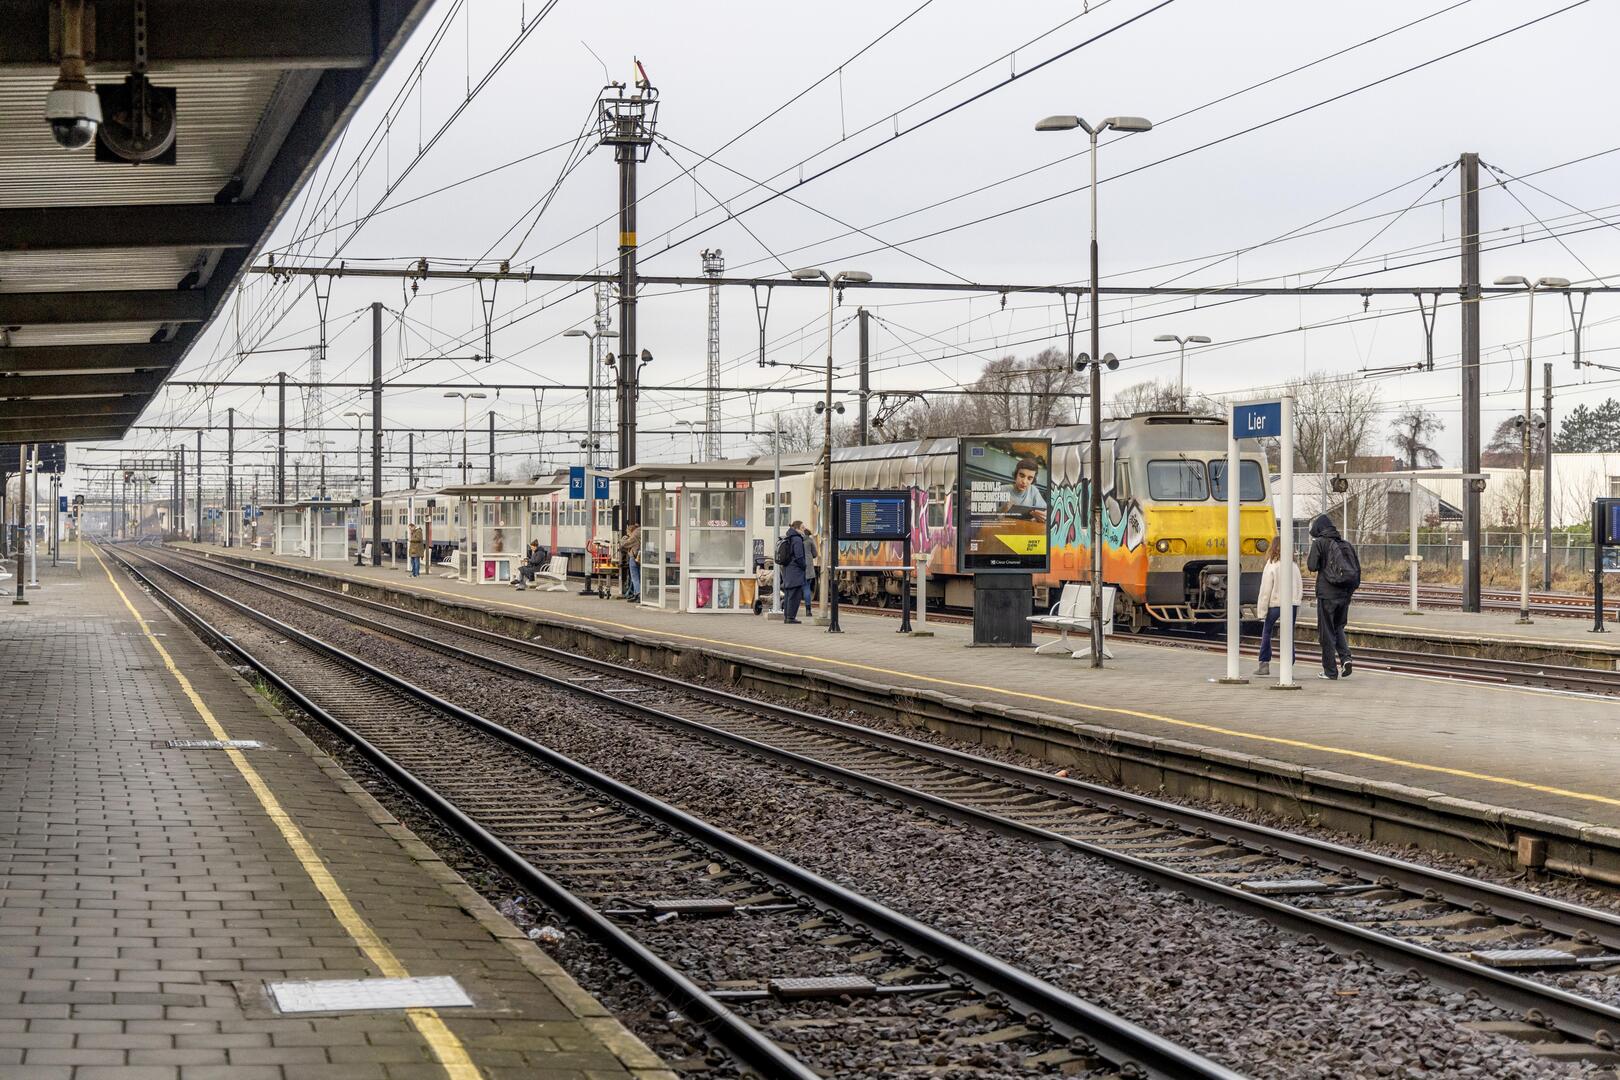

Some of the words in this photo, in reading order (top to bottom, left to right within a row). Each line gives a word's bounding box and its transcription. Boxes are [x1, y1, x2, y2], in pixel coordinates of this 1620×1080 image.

[1248, 411, 1266, 430] Lier
[971, 481, 1001, 491] ONDERWIJS
[1206, 538, 1226, 548] 414
